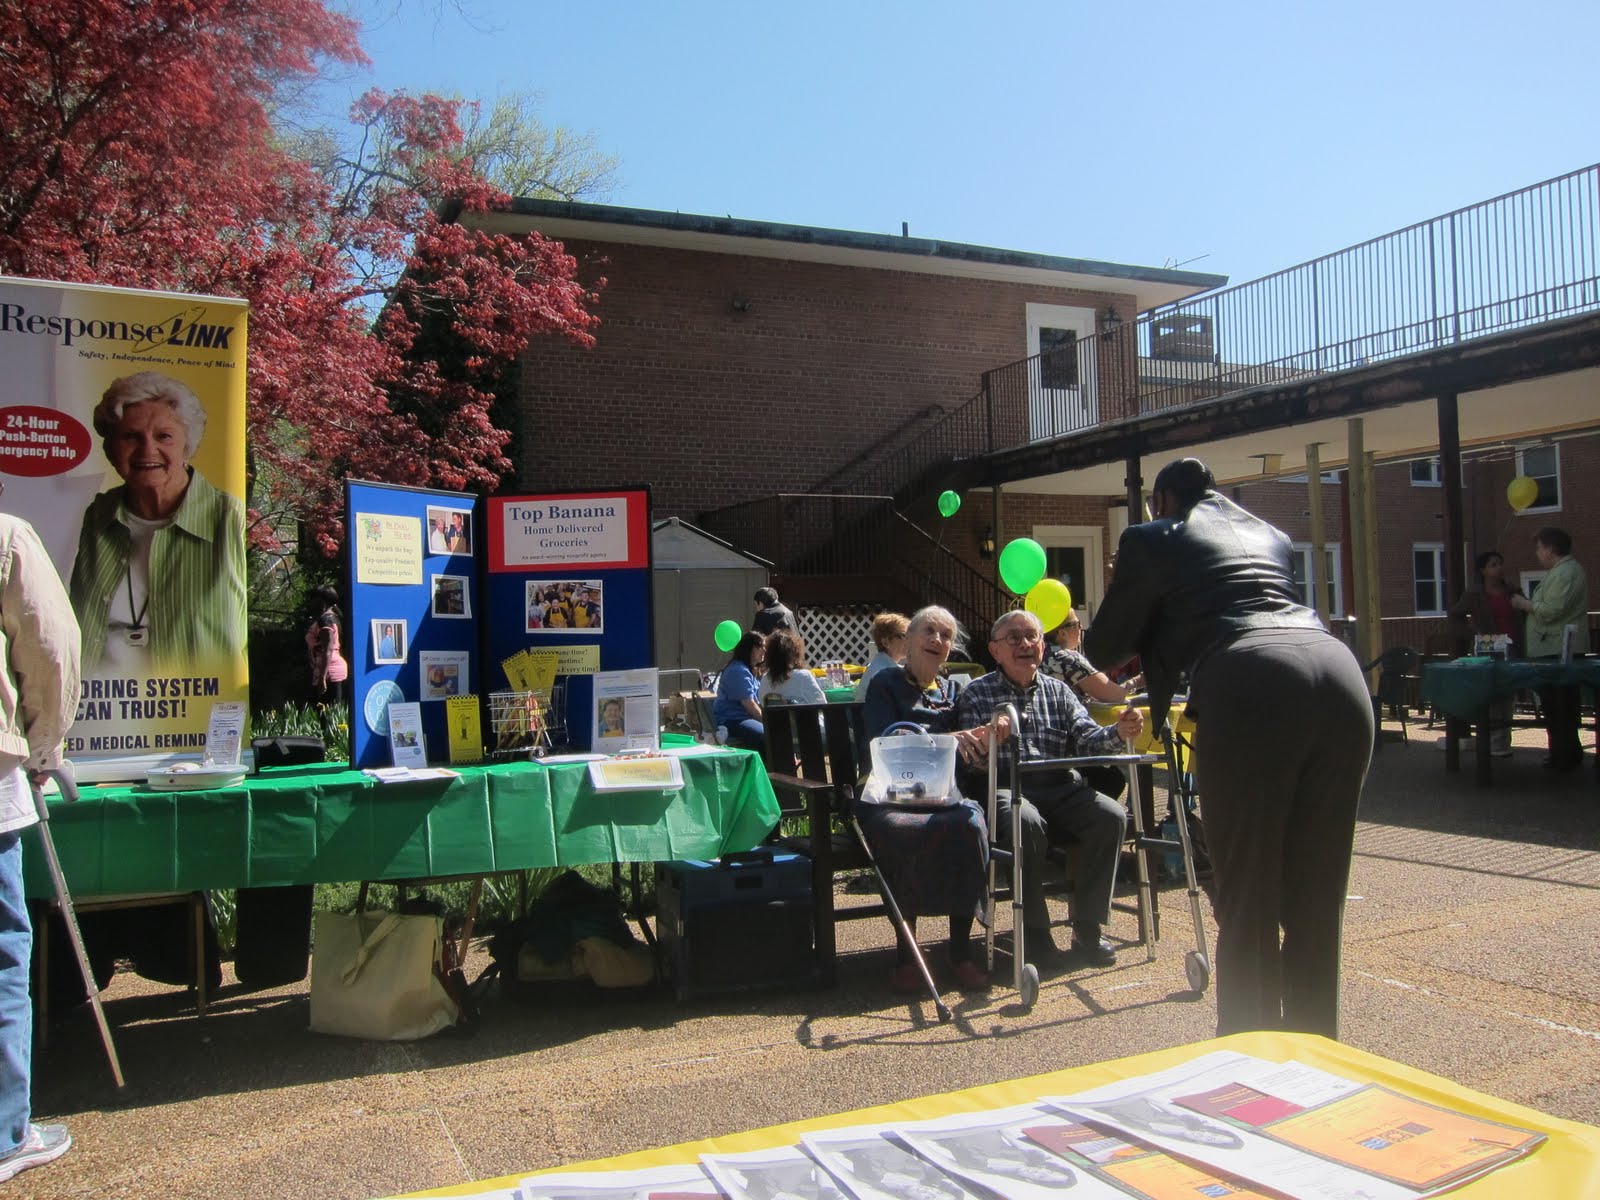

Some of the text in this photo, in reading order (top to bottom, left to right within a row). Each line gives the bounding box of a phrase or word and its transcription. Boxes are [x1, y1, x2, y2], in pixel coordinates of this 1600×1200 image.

[78, 350, 236, 369] Safety, Independence, Peace of Mind
[7, 415, 60, 430] 24-Hour
[0, 429, 67, 444] Push-Button
[52, 446, 76, 460] Help
[509, 505, 616, 523] Top Banana
[524, 523, 604, 535] Home Delivered
[539, 537, 588, 548] Groceries
[561, 666, 580, 674] Every
[146, 677, 219, 697] SYSTEM
[75, 699, 186, 721] CAN TRUST!
[90, 735, 150, 750] MEDICAL
